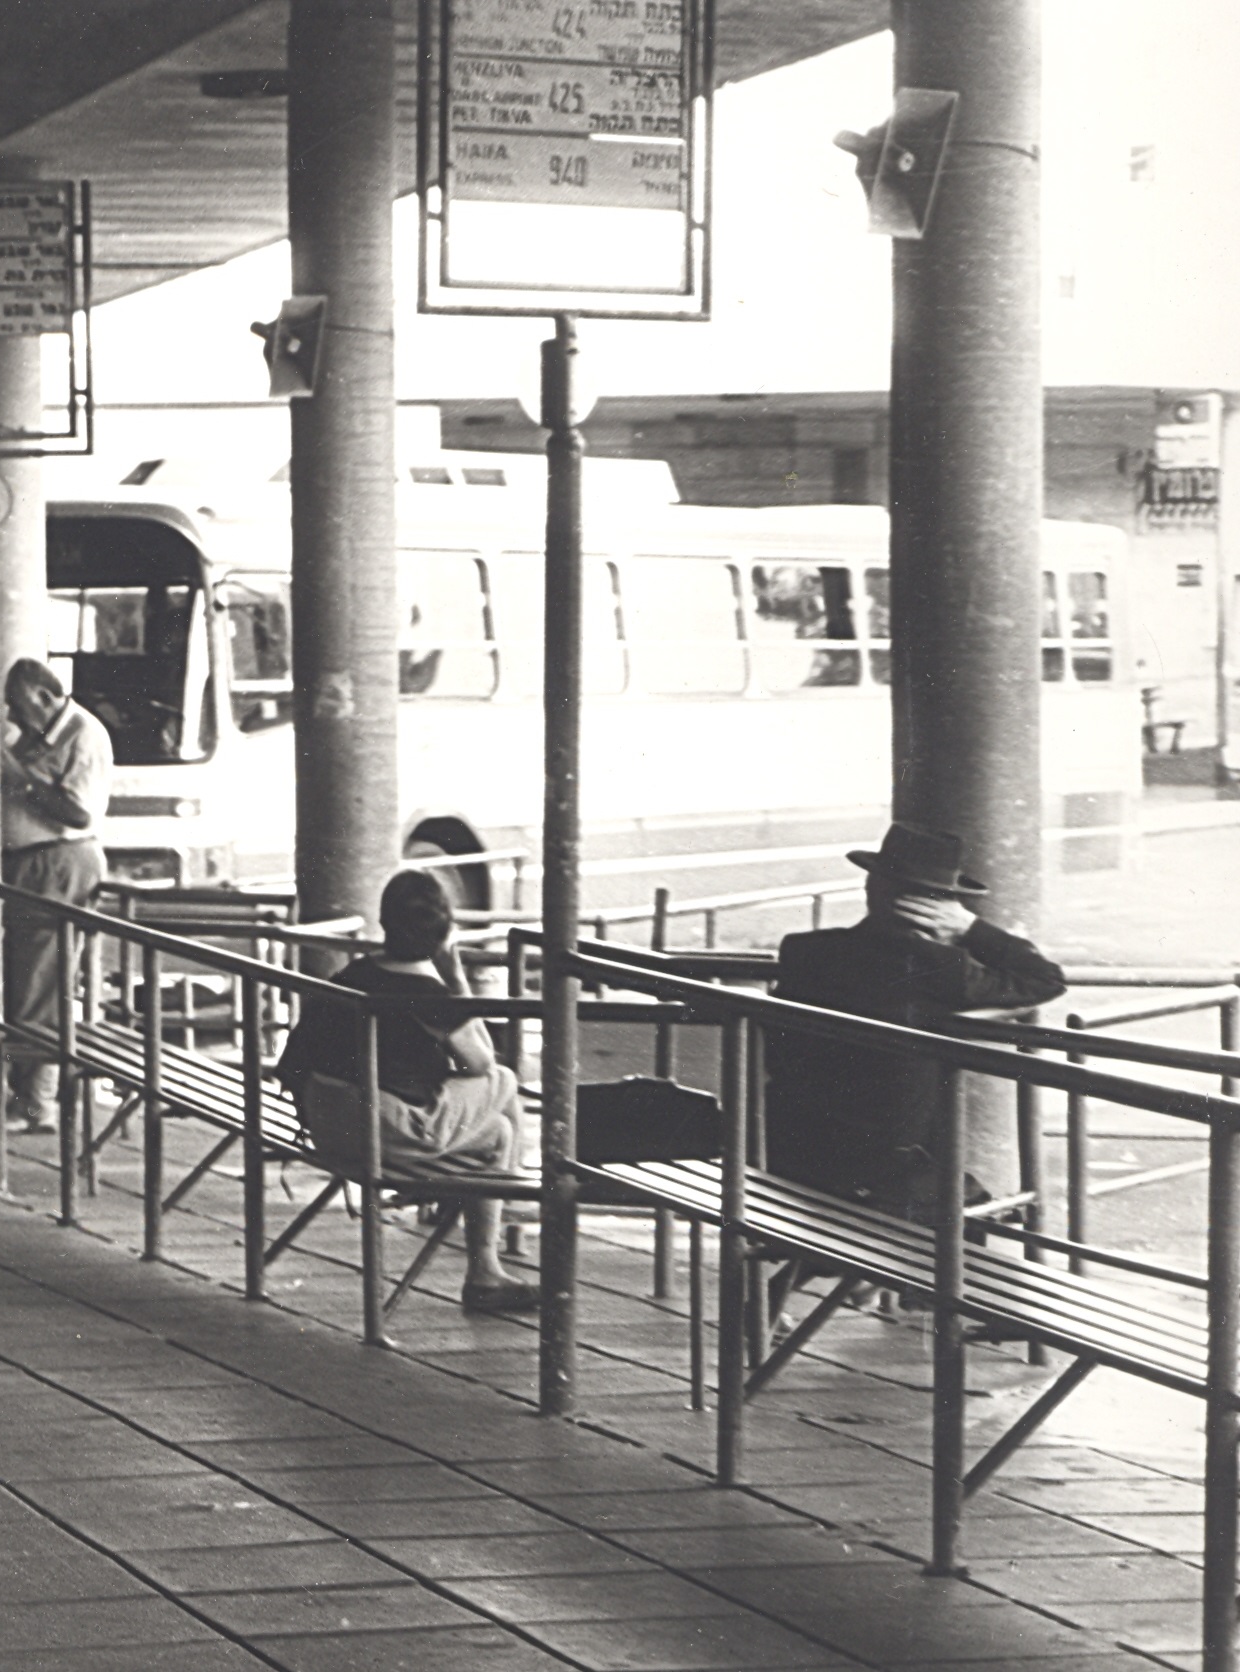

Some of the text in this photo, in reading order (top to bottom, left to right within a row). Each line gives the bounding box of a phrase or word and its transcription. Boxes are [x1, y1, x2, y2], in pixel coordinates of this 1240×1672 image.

[551, 8, 586, 39] 424
[548, 81, 585, 115] 425
[548, 154, 589, 188] 940
